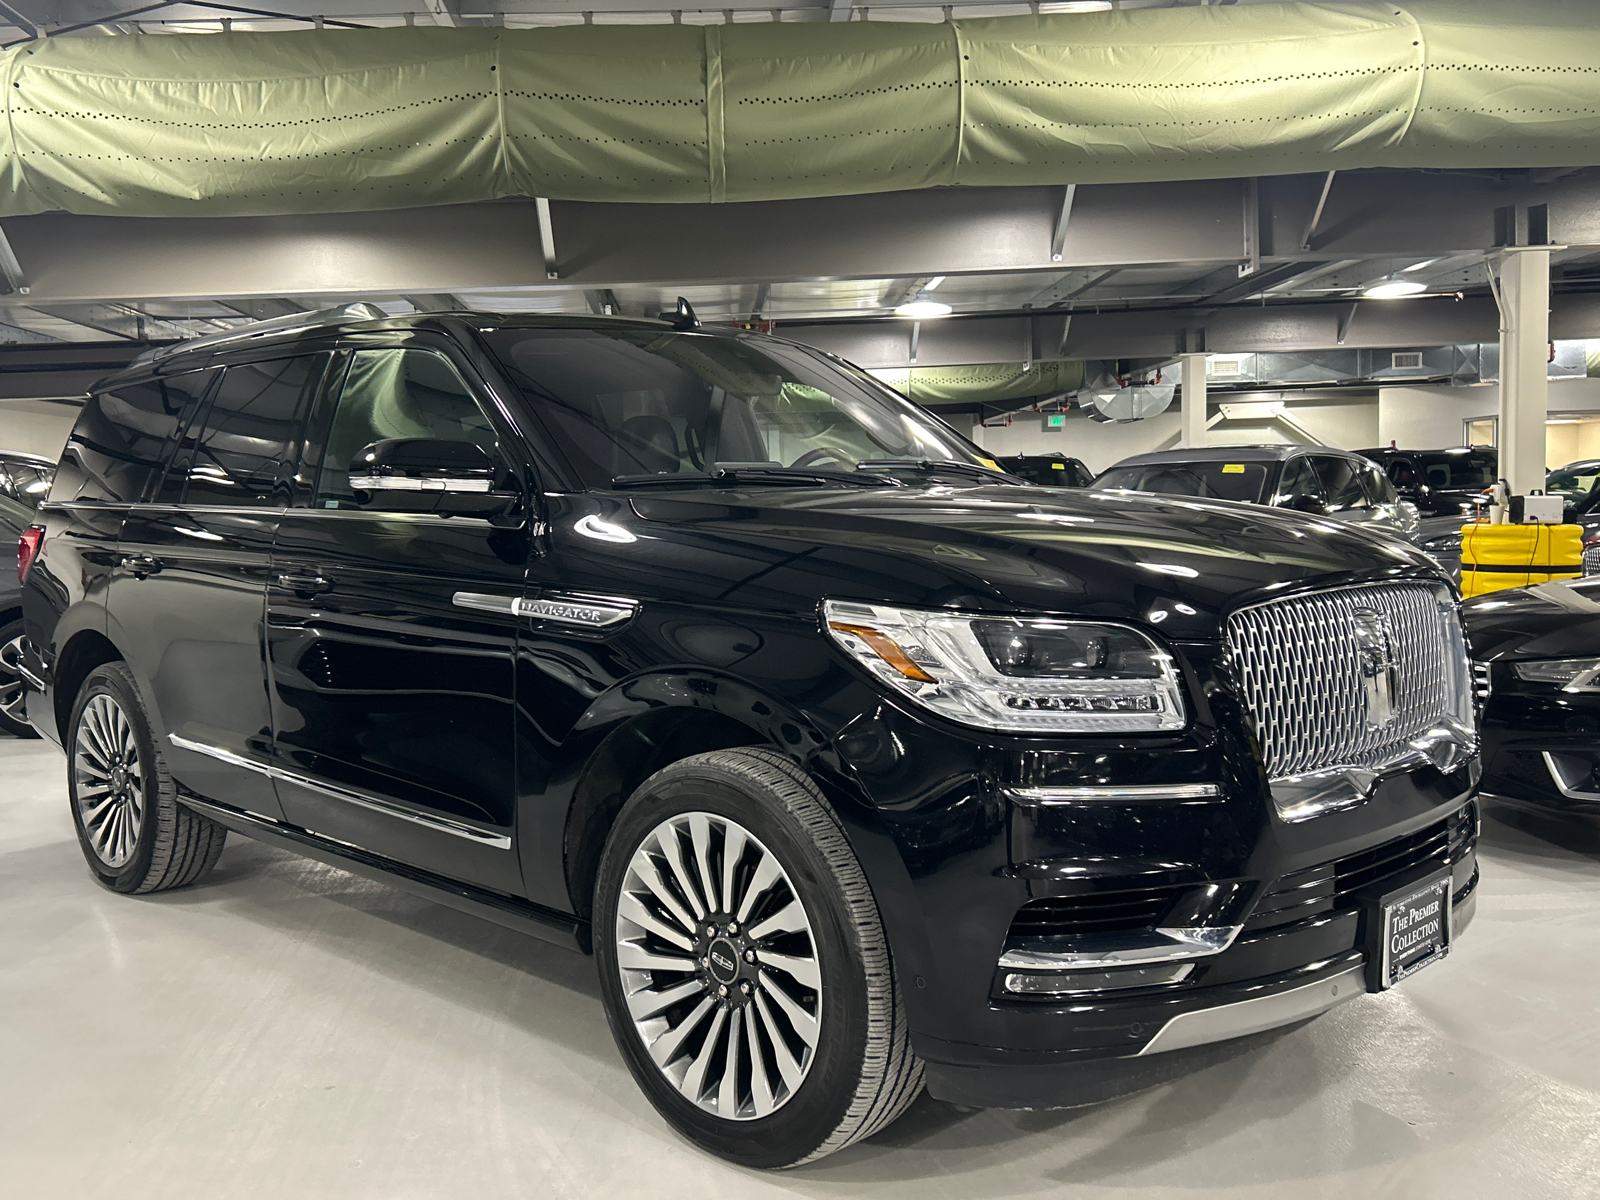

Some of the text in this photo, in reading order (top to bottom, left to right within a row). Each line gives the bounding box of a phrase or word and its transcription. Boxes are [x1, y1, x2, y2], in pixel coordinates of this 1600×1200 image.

[521, 602, 601, 621] NAVIGATOR
[1392, 900, 1440, 935] THE PREMIER
[1391, 918, 1439, 954] COLLECTION
